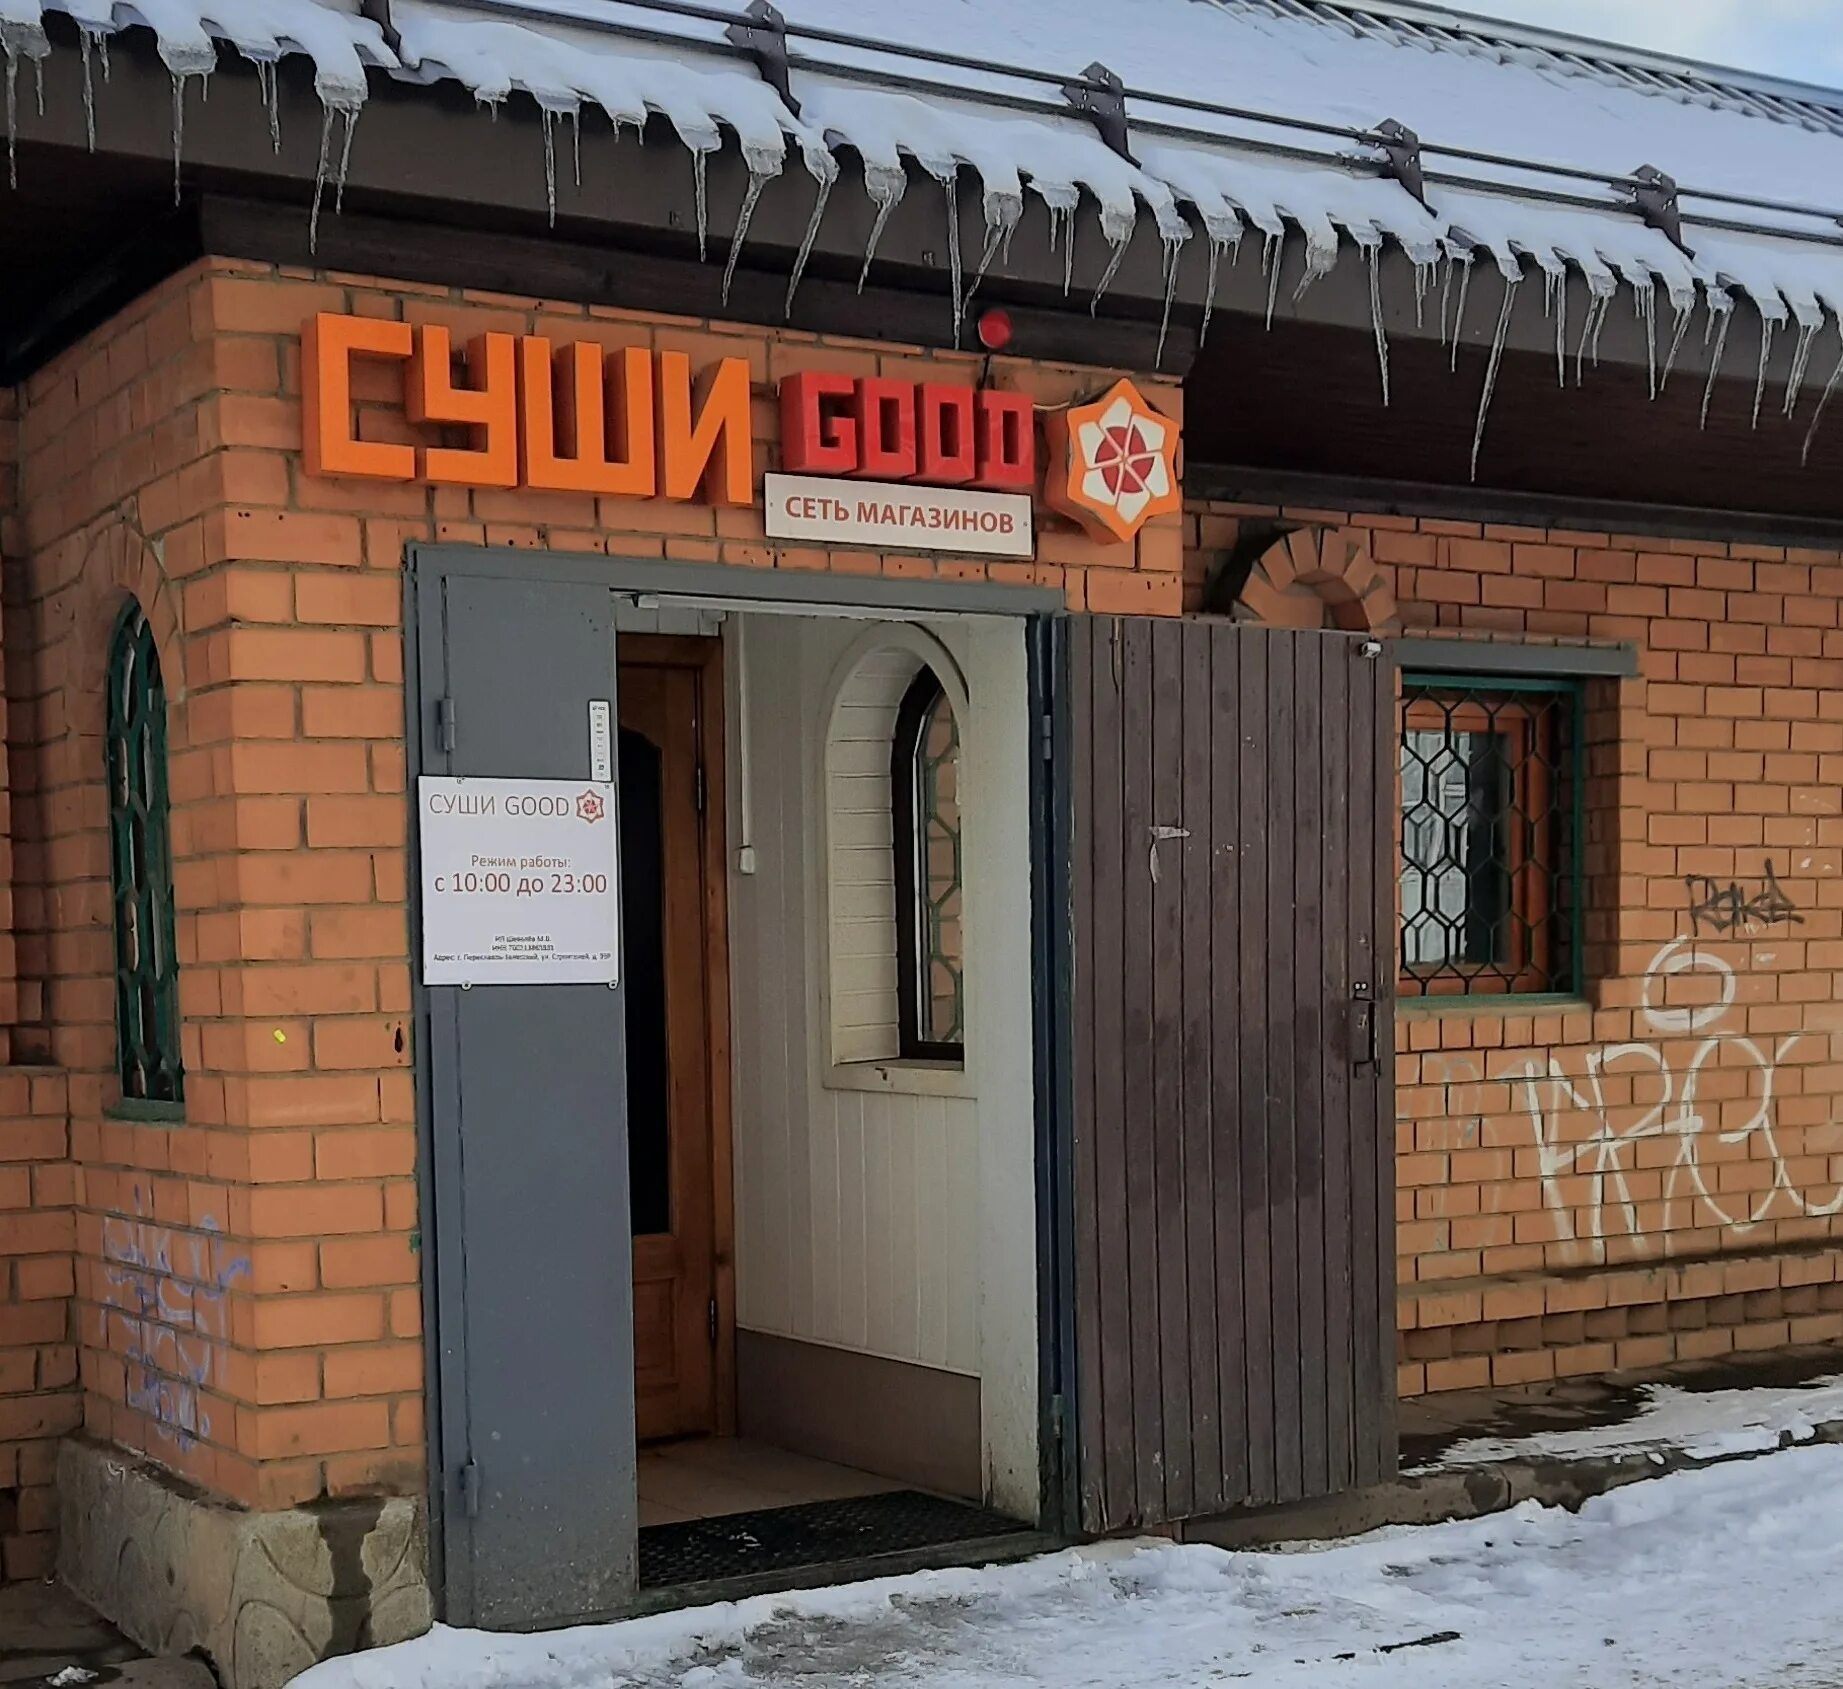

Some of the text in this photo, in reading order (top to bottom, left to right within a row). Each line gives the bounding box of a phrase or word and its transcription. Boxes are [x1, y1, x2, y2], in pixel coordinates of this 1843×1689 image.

[303, 312, 1034, 505] СУШИ GOOD
[785, 496, 1014, 534] СЕТЬ МАГАЗИНОВ
[429, 793, 570, 817] СУШИ GOOD
[471, 854, 571, 870] Режим работы:
[434, 872, 607, 896] с 10:00 до 23:00
